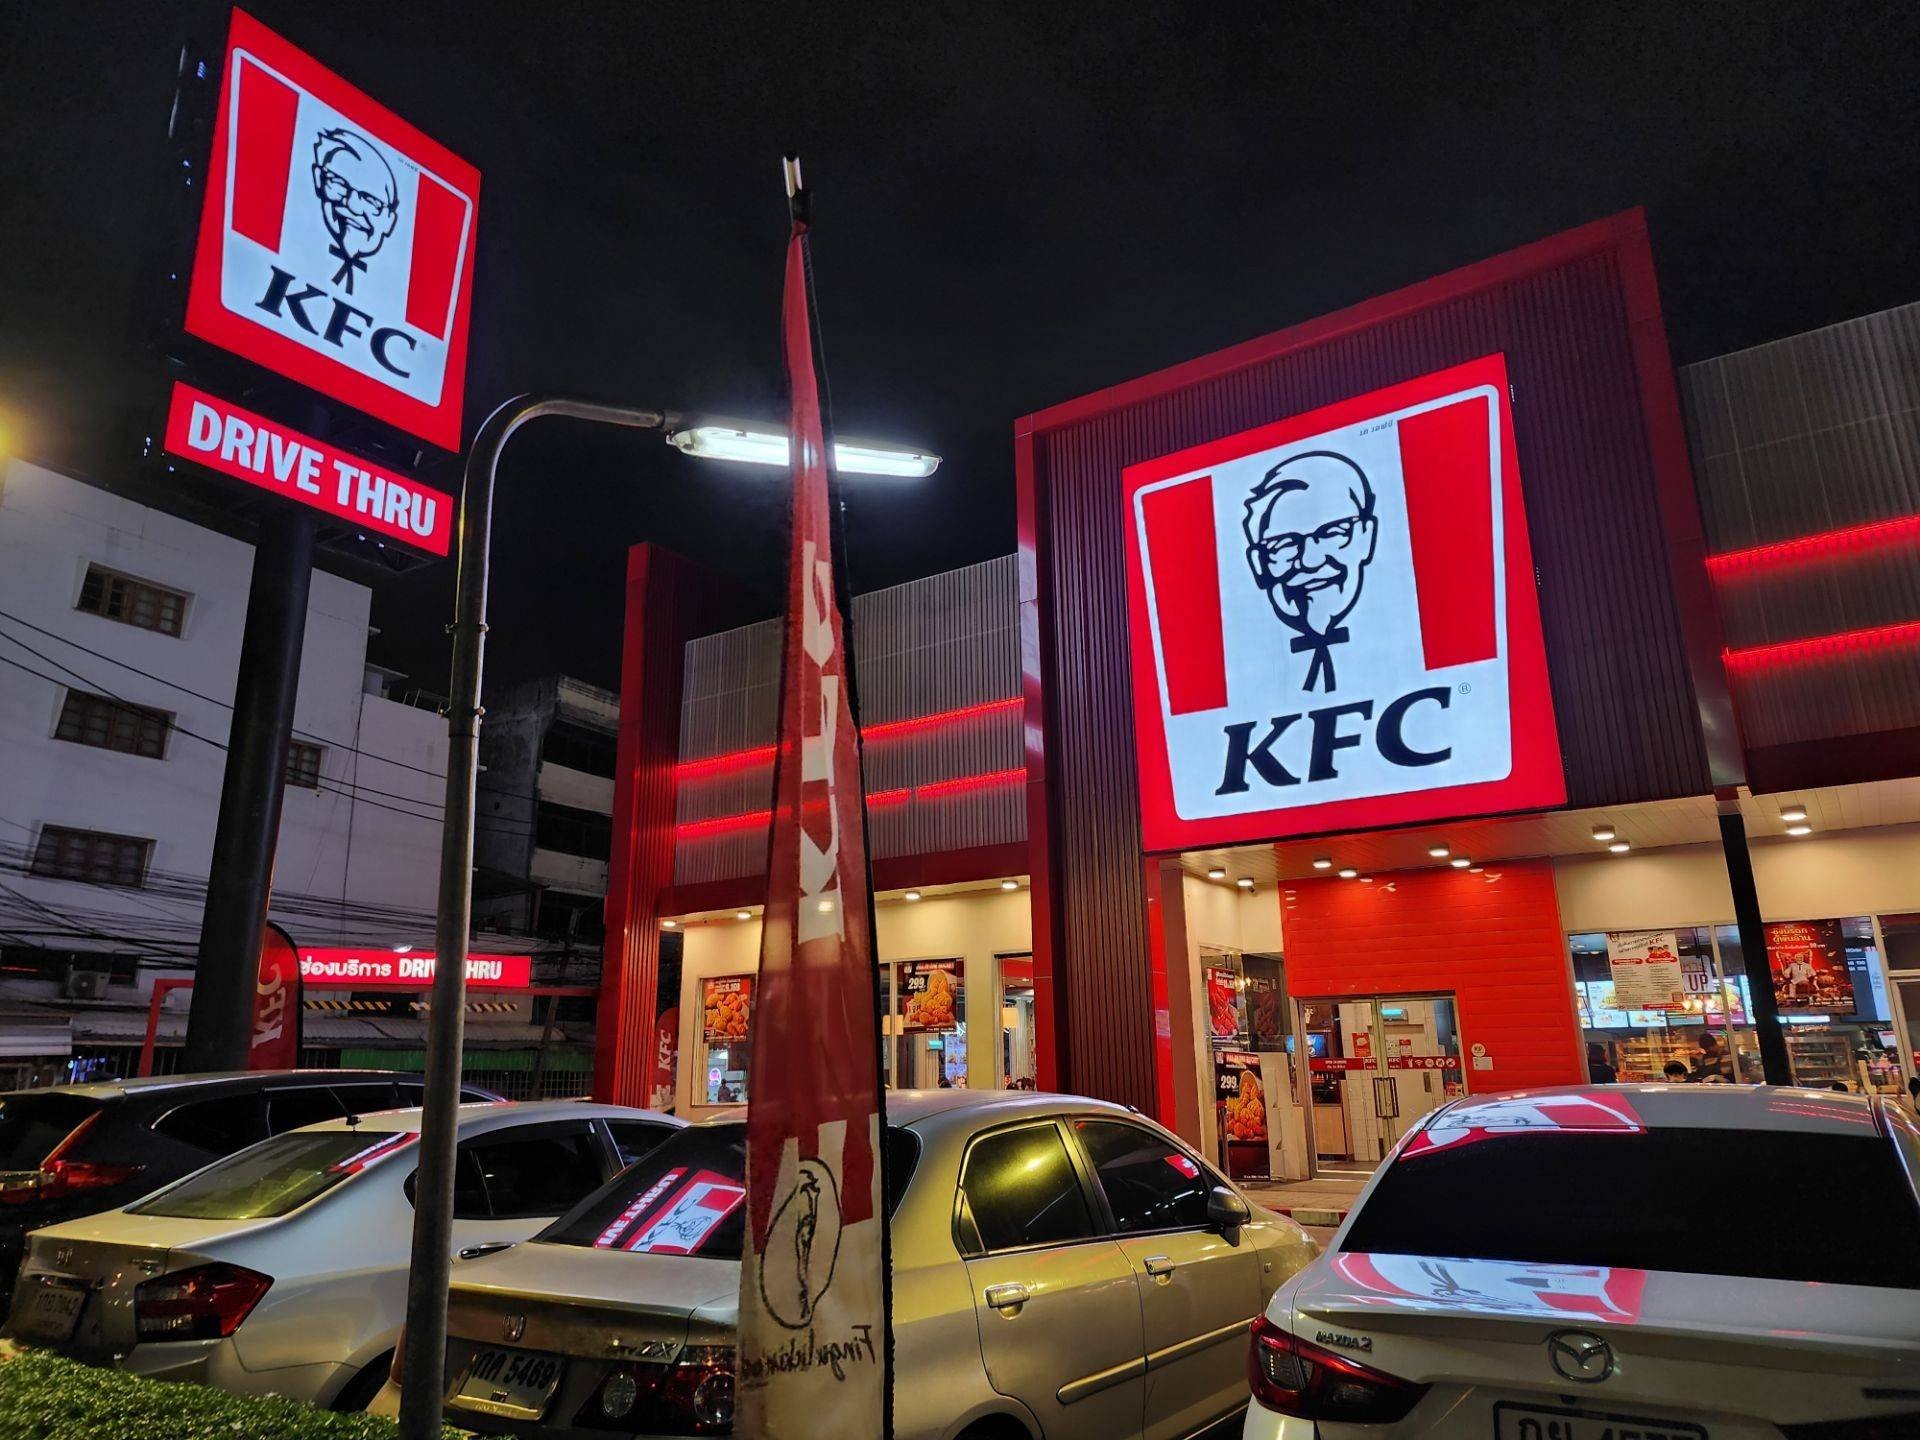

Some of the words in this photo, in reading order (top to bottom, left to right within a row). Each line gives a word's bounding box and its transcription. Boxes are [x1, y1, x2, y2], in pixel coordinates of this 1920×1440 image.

[256, 265, 418, 379] KFC
[187, 400, 325, 496] DRIVE
[333, 459, 437, 537] THRU
[1215, 686, 1452, 796] KFC
[398, 957, 436, 981] DRI
[465, 960, 503, 980] HRU
[657, 1029, 672, 1071] KFC
